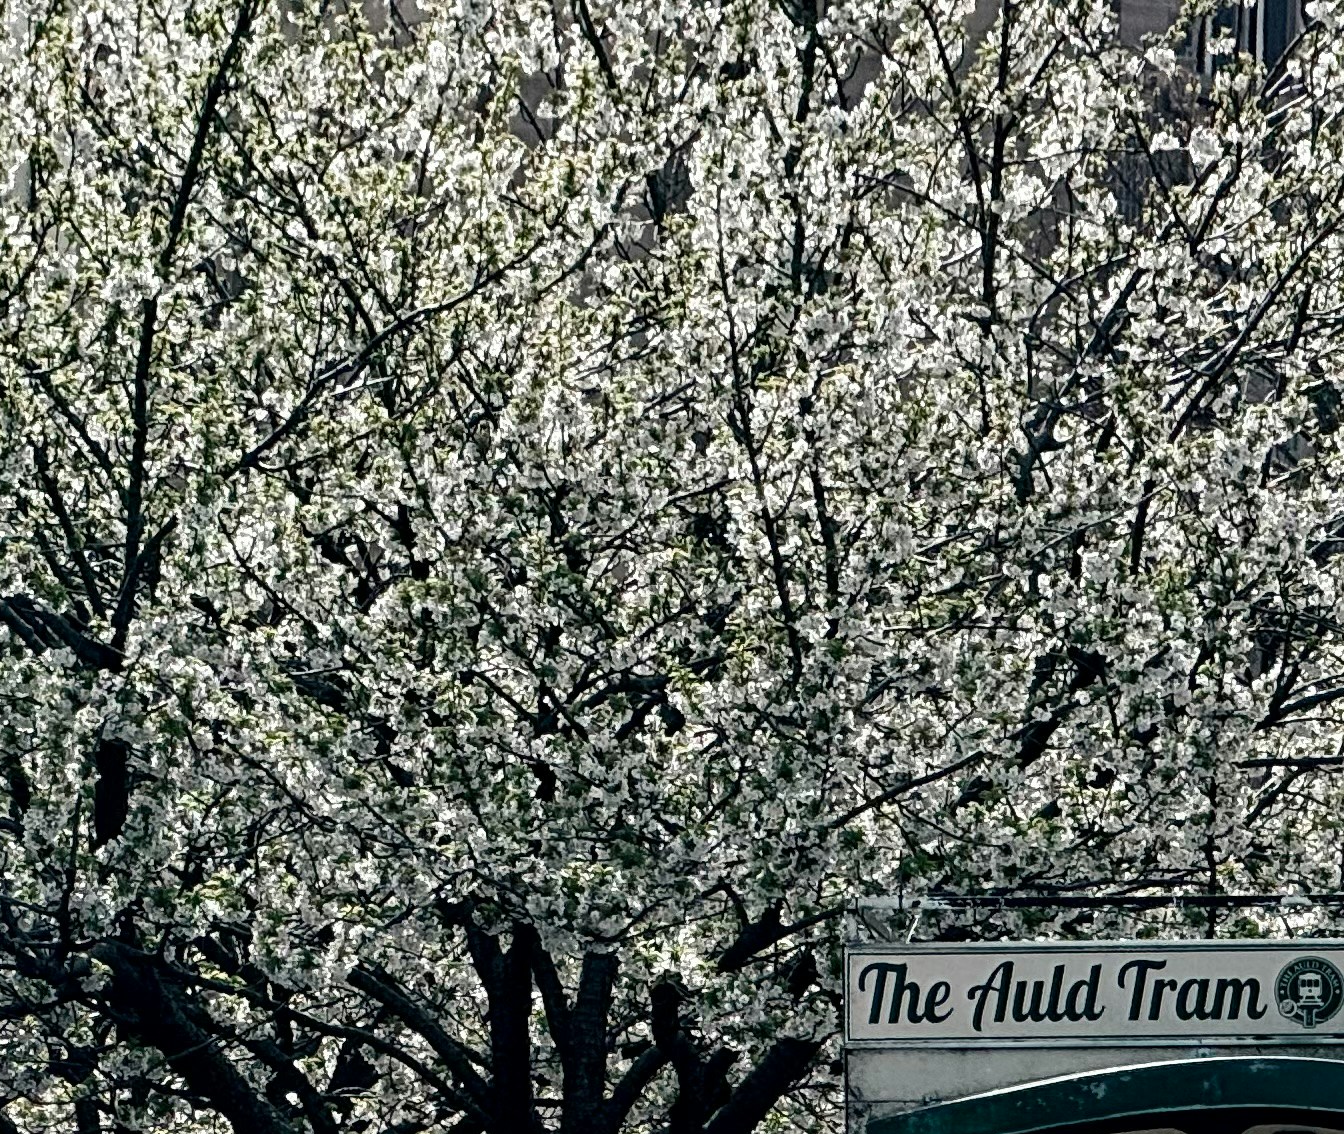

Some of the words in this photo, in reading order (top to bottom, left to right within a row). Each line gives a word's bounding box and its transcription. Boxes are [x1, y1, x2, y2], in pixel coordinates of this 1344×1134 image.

[858, 962, 954, 1024] The
[967, 960, 1106, 1032] Auld
[1117, 959, 1268, 1021] Tram
